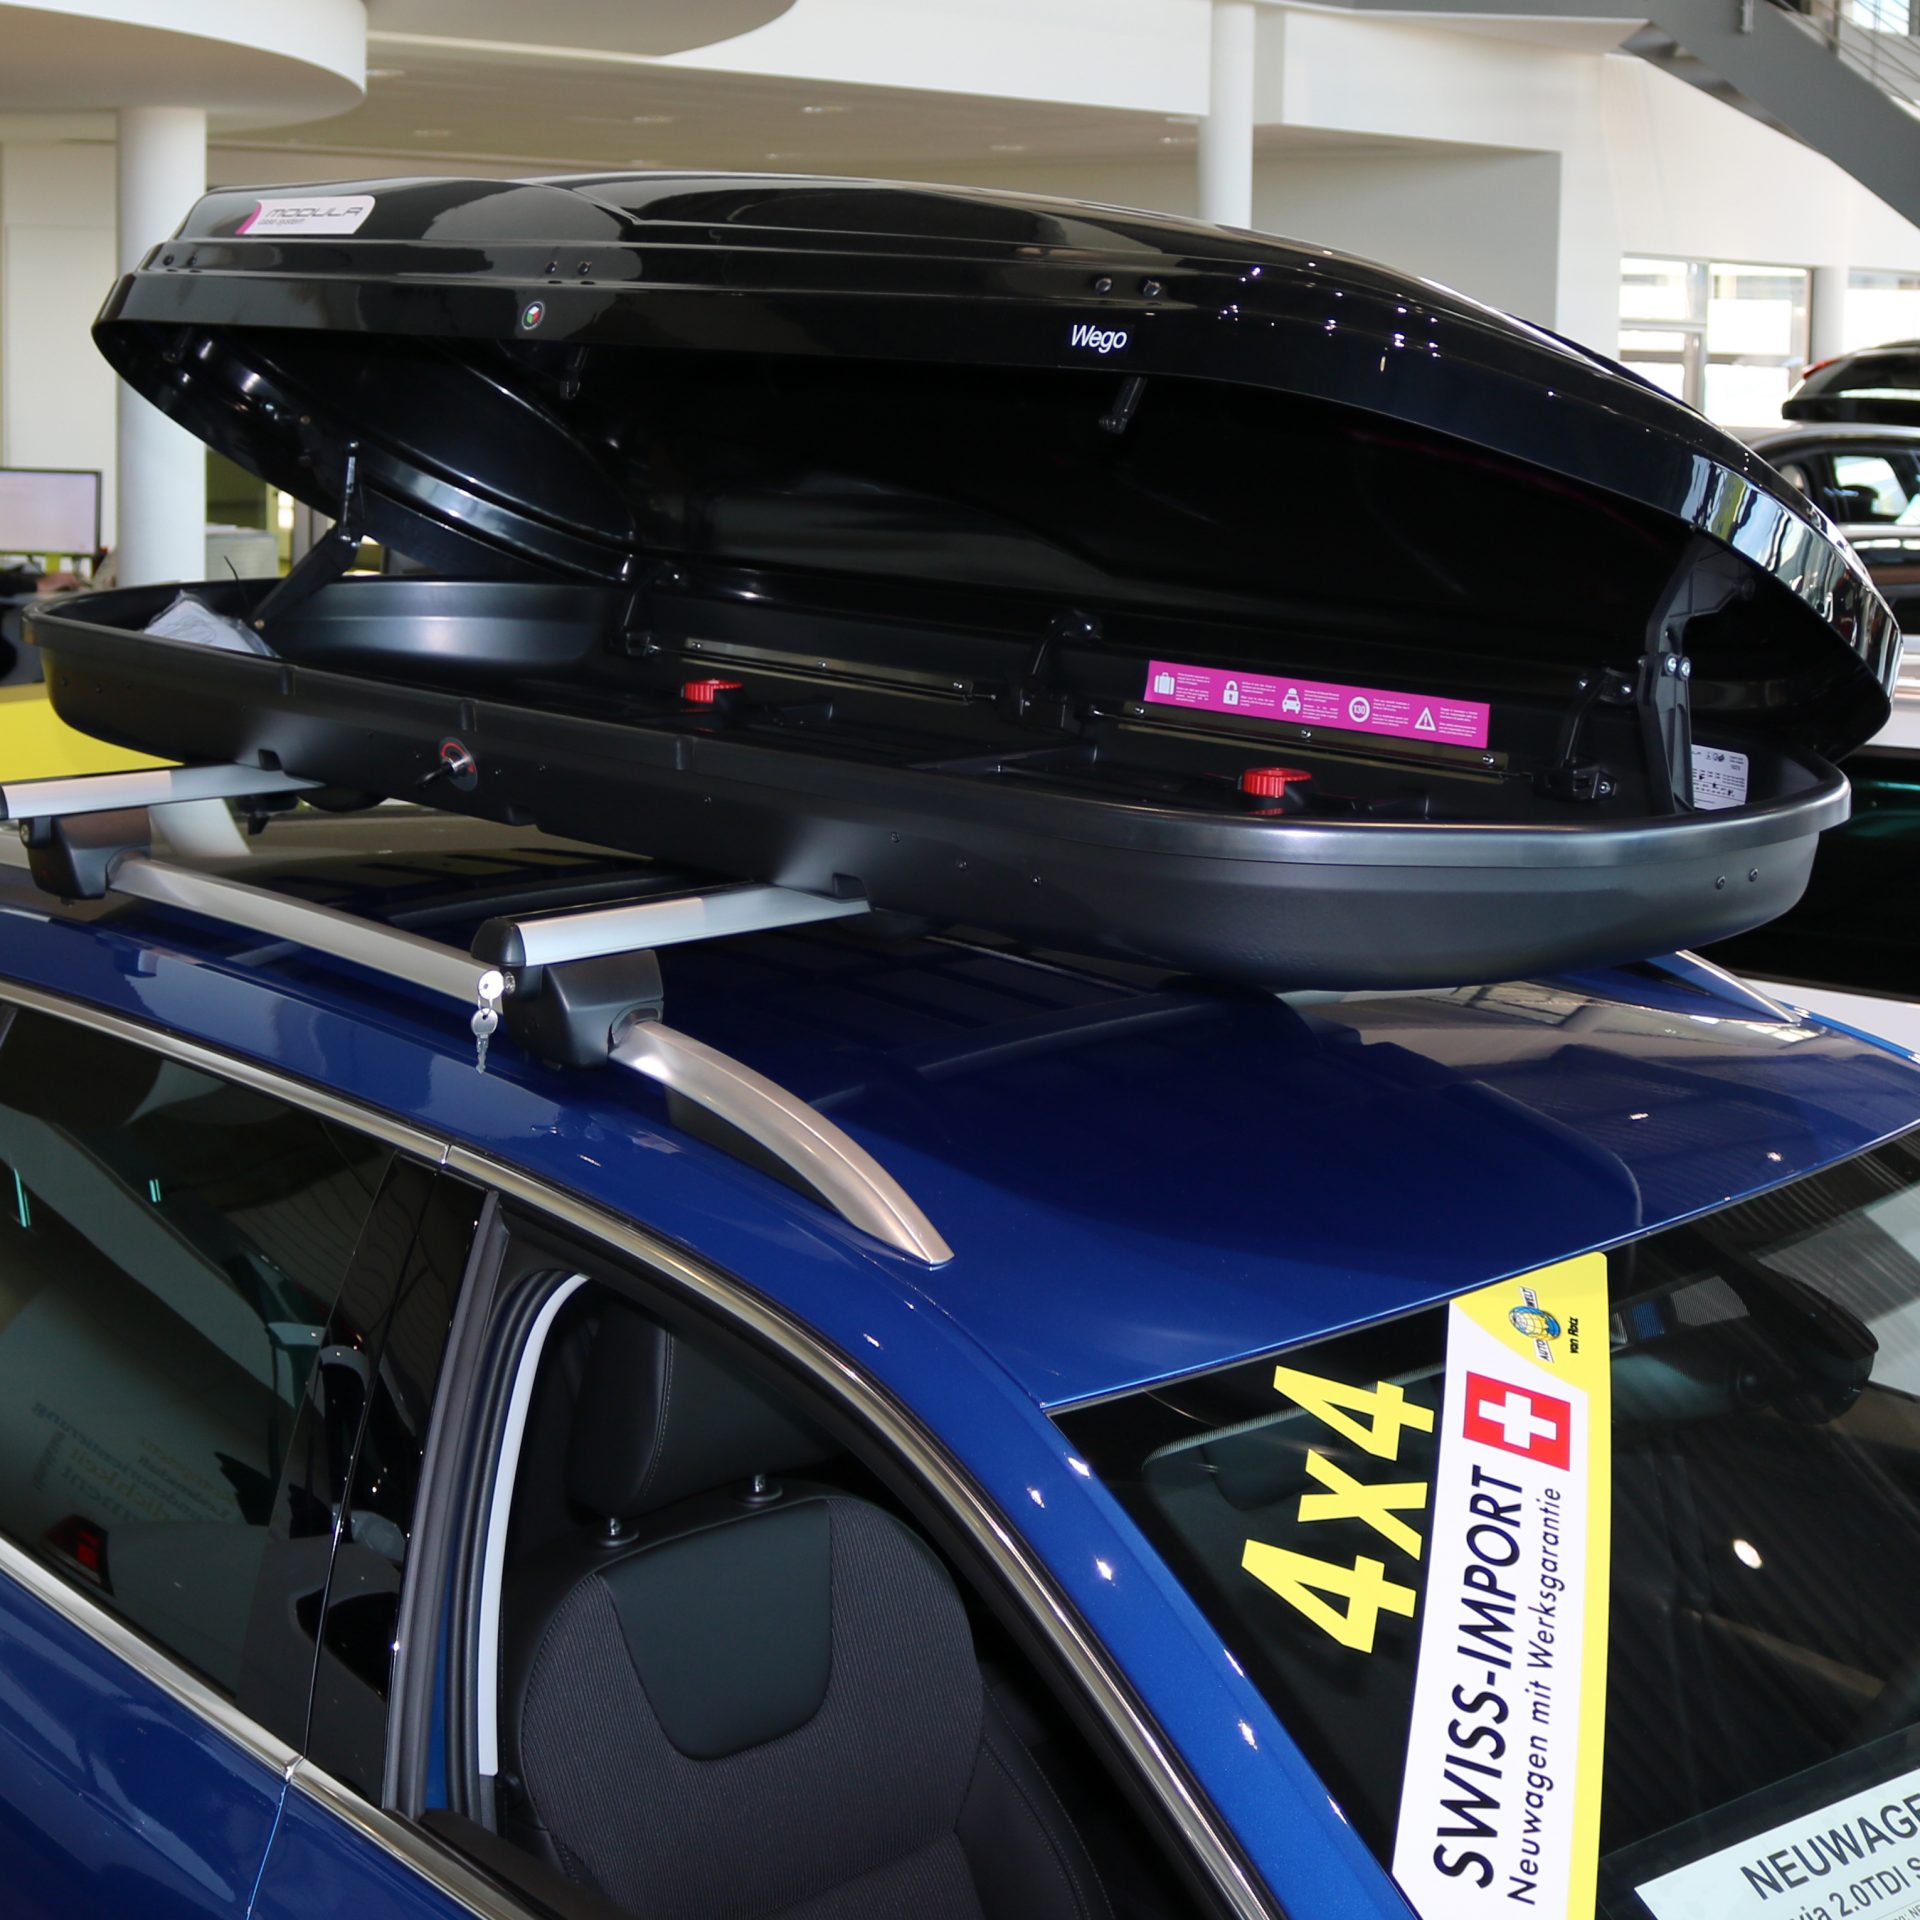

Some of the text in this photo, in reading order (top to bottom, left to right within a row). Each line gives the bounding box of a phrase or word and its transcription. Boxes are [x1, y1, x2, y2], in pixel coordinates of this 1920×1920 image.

[264, 206, 363, 218] MODULA
[1071, 324, 1128, 354] Wego
[1536, 1339, 1550, 1362] AUTO
[1433, 1464, 1523, 1889] SWISS-IMPORT
[1507, 1487, 1565, 1905] Neuwagen mit Werksgarantie
[1828, 1866, 1912, 1918] 2.0TDI
